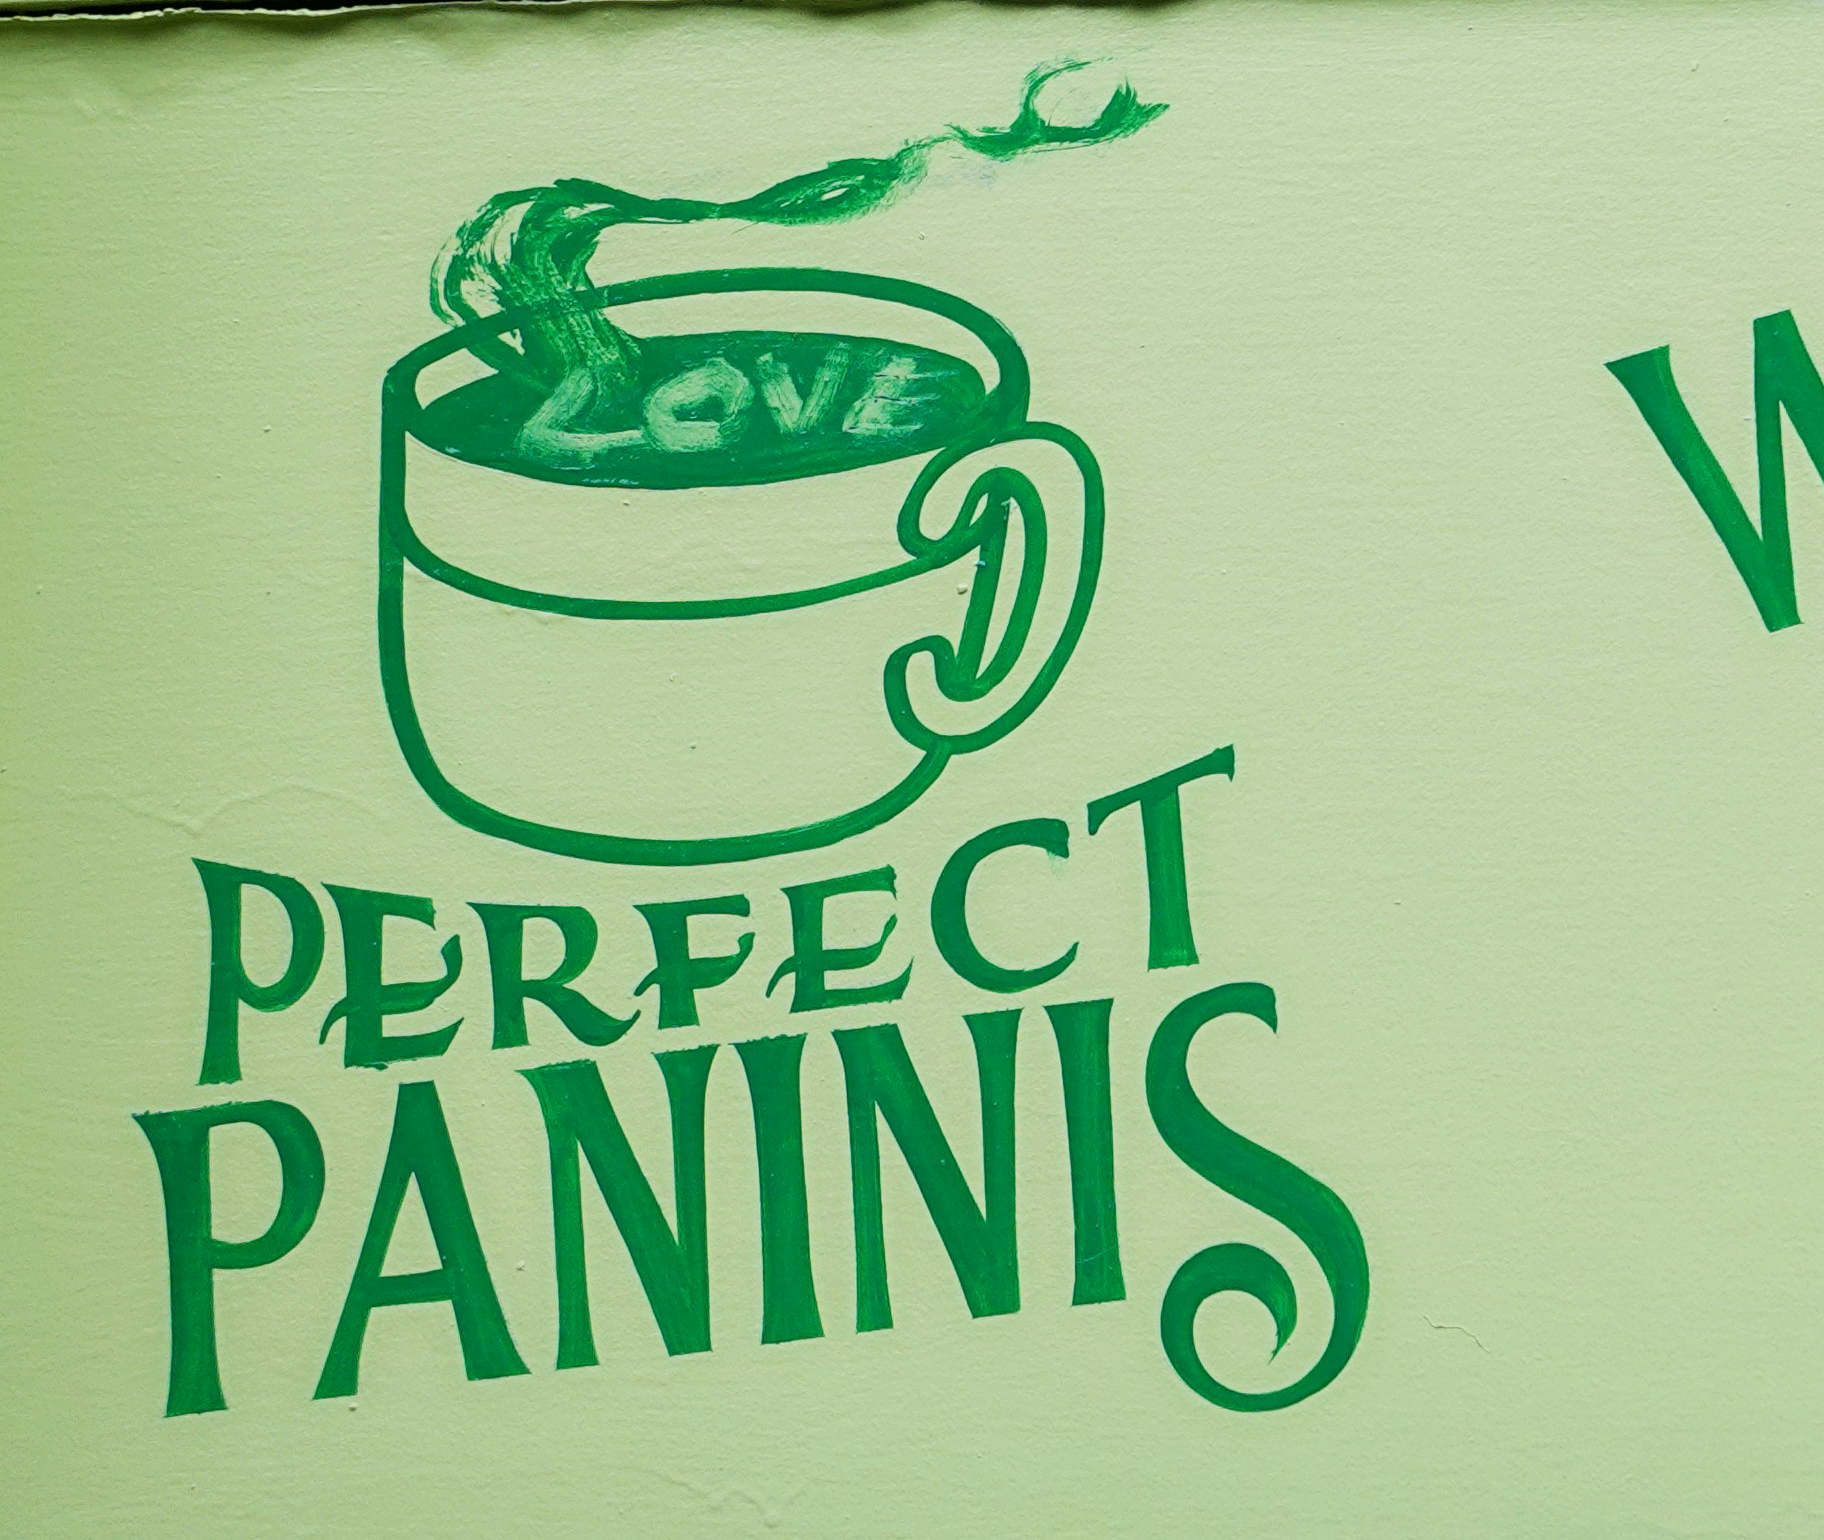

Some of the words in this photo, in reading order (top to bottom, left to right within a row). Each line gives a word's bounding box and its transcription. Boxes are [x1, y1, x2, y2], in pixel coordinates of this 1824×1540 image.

[515, 340, 952, 456] LOVE
[190, 744, 1236, 1087] PERFECT
[131, 980, 1371, 1419] PANINIS
